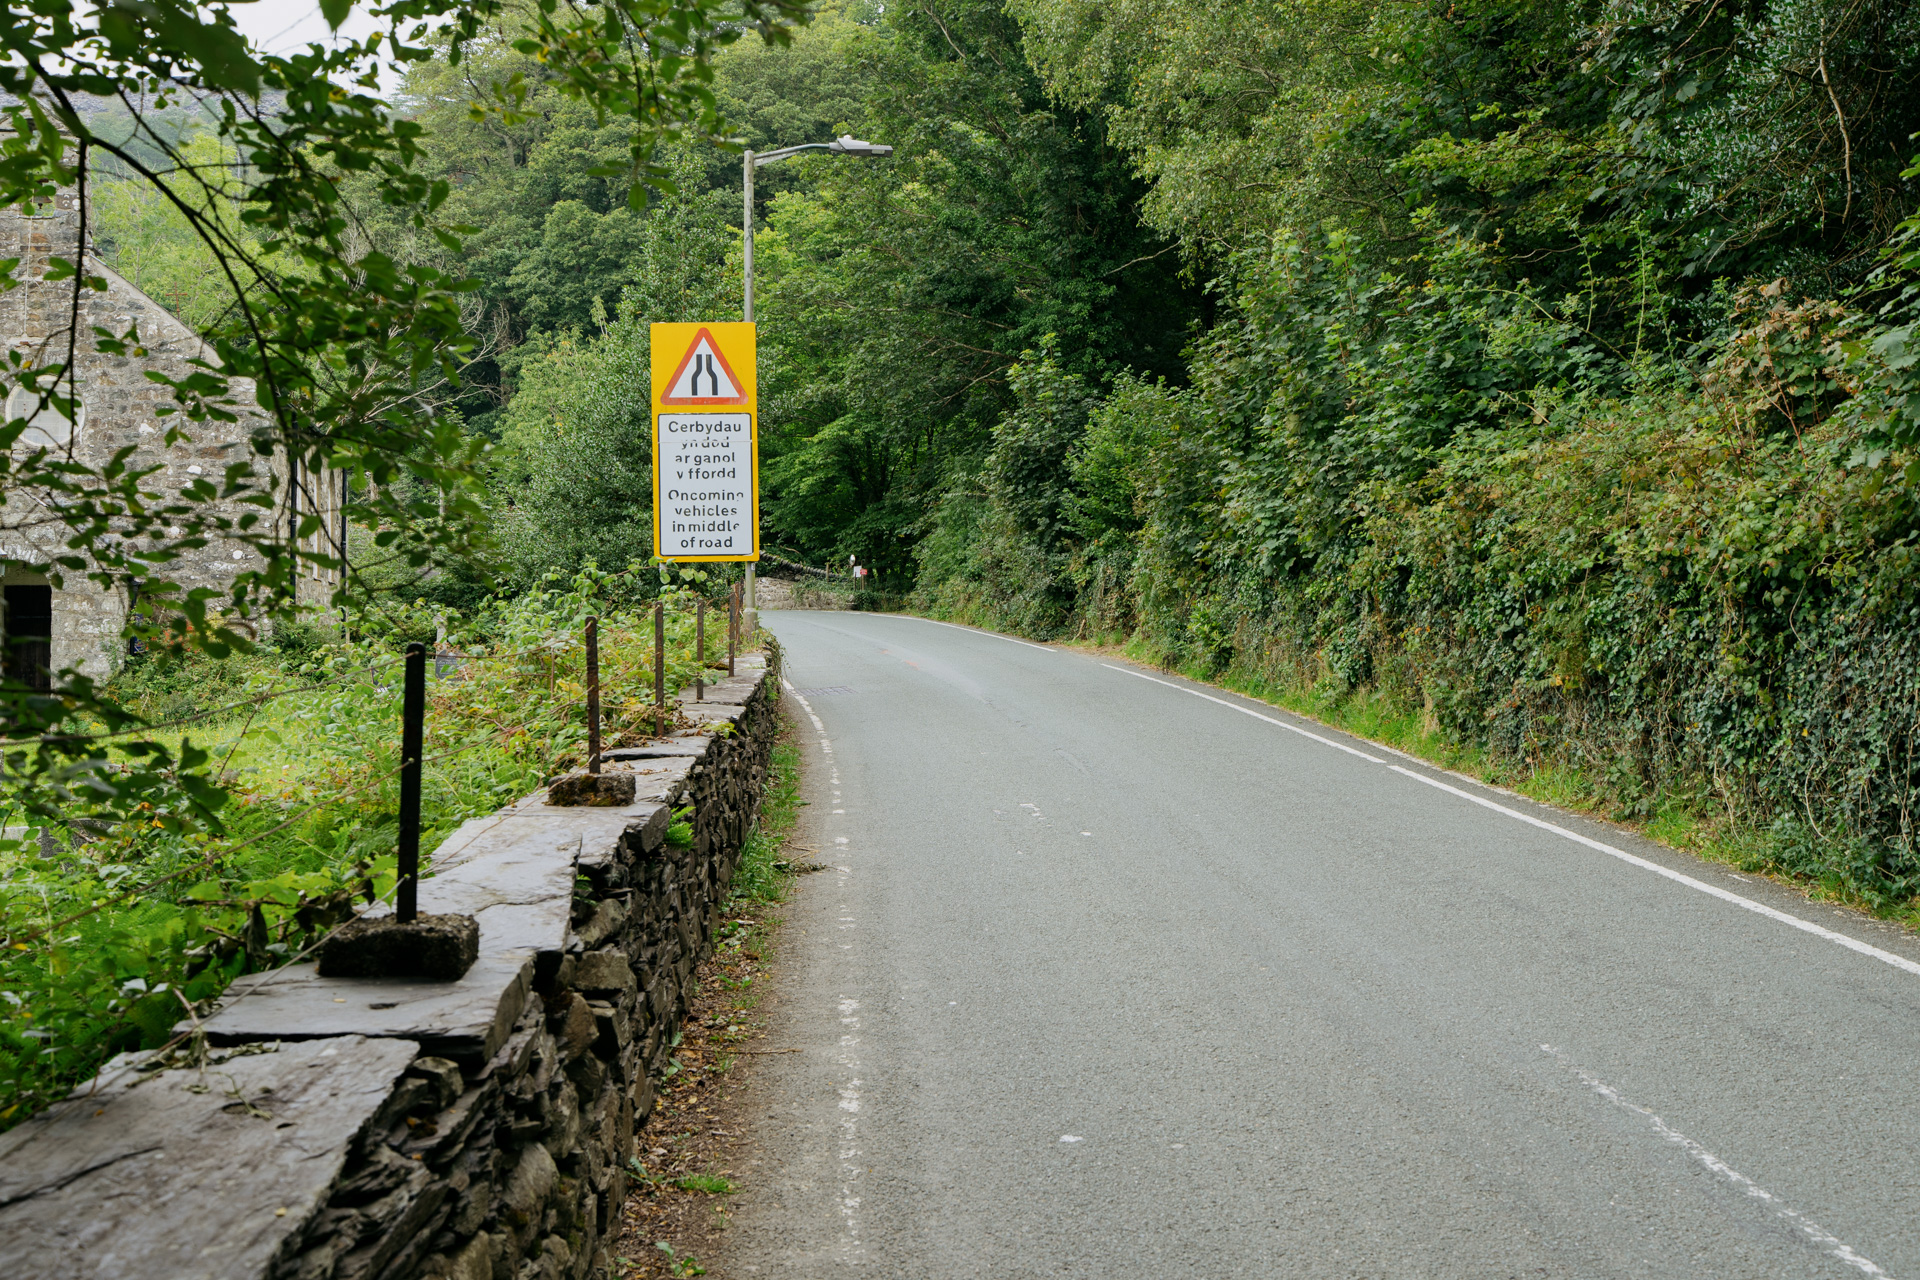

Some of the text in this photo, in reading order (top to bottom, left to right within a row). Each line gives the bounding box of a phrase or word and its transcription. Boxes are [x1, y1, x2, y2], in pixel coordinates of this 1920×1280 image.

[668, 420, 742, 434] Cerbydau
[675, 451, 736, 466] ar ganol
[688, 467, 736, 480] ffordd
[674, 504, 738, 517] vehicles
[672, 520, 685, 533] in
[680, 535, 733, 548] of road
